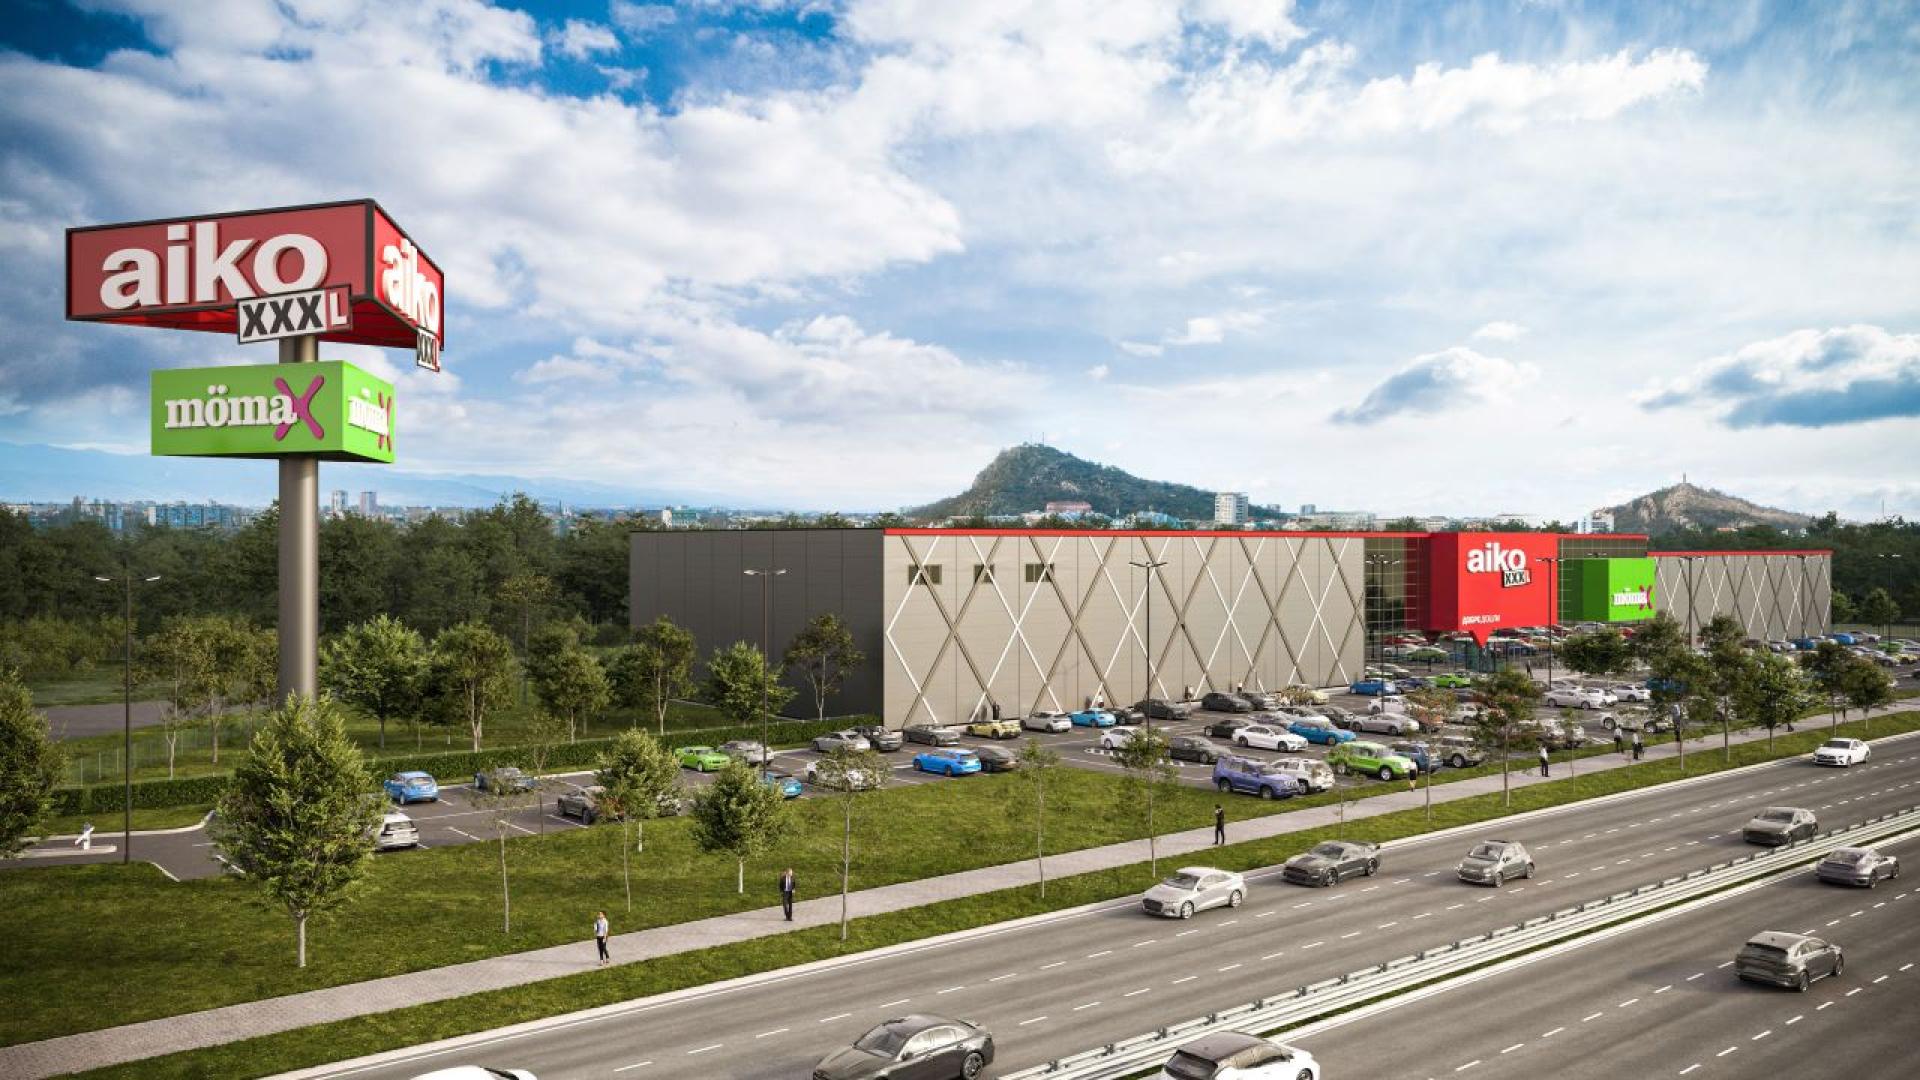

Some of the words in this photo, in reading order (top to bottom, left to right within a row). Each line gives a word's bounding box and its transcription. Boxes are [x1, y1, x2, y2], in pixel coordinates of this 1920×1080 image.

[100, 222, 328, 310] aiko
[382, 238, 440, 335] aiko
[242, 291, 347, 339] XXXL
[1467, 542, 1526, 573] aiko
